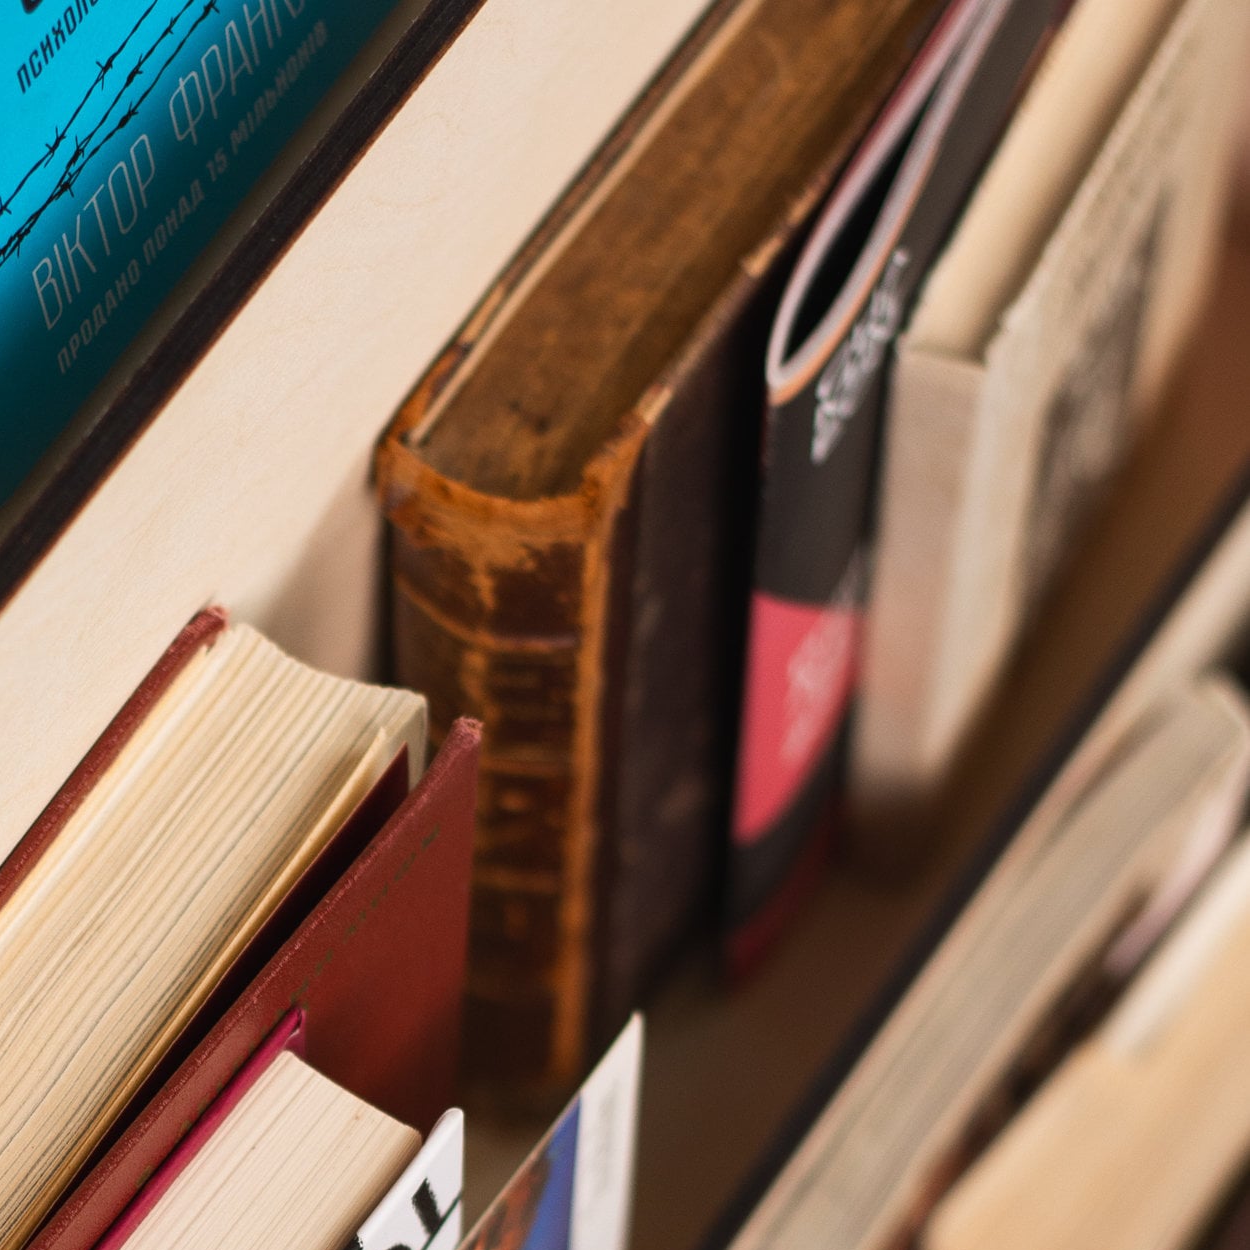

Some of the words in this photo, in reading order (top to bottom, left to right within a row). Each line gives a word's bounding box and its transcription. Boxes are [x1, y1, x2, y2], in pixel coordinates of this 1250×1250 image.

[32, 133, 156, 331] ВІКТОР
[169, 0, 307, 146] ФРАН
[56, 259, 140, 374] ПРОДАНО
[141, 179, 205, 266] ПОНАД
[206, 147, 228, 182] 15
